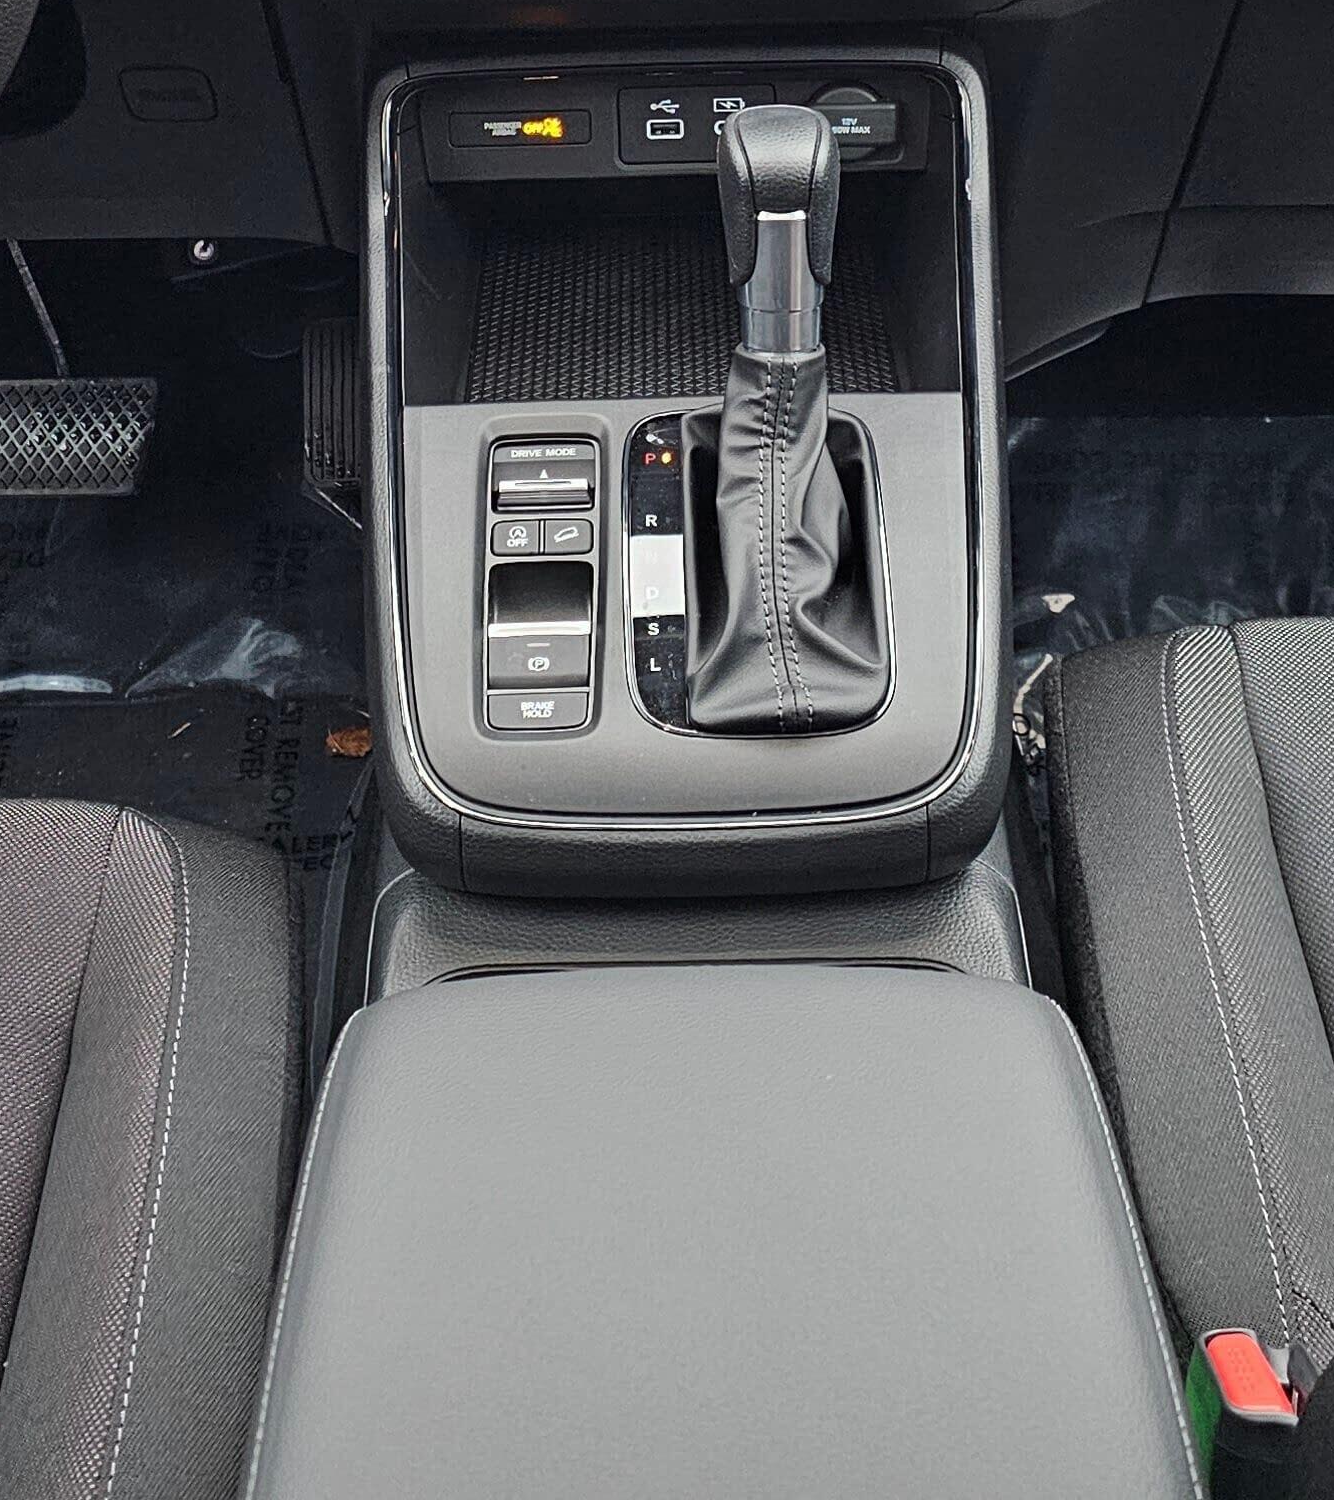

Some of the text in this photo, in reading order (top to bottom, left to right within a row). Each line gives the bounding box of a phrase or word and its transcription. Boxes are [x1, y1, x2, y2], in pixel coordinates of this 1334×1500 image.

[851, 126, 871, 134] MAX
[511, 447, 576, 458] DRIVE MODE
[645, 453, 656, 464] P
[645, 515, 657, 527] R
[507, 538, 528, 547] OFF
[645, 586, 659, 599] D
[648, 623, 659, 635] S
[649, 658, 661, 672] L
[520, 700, 555, 711] BRAKE
[523, 708, 552, 718] HOLD
